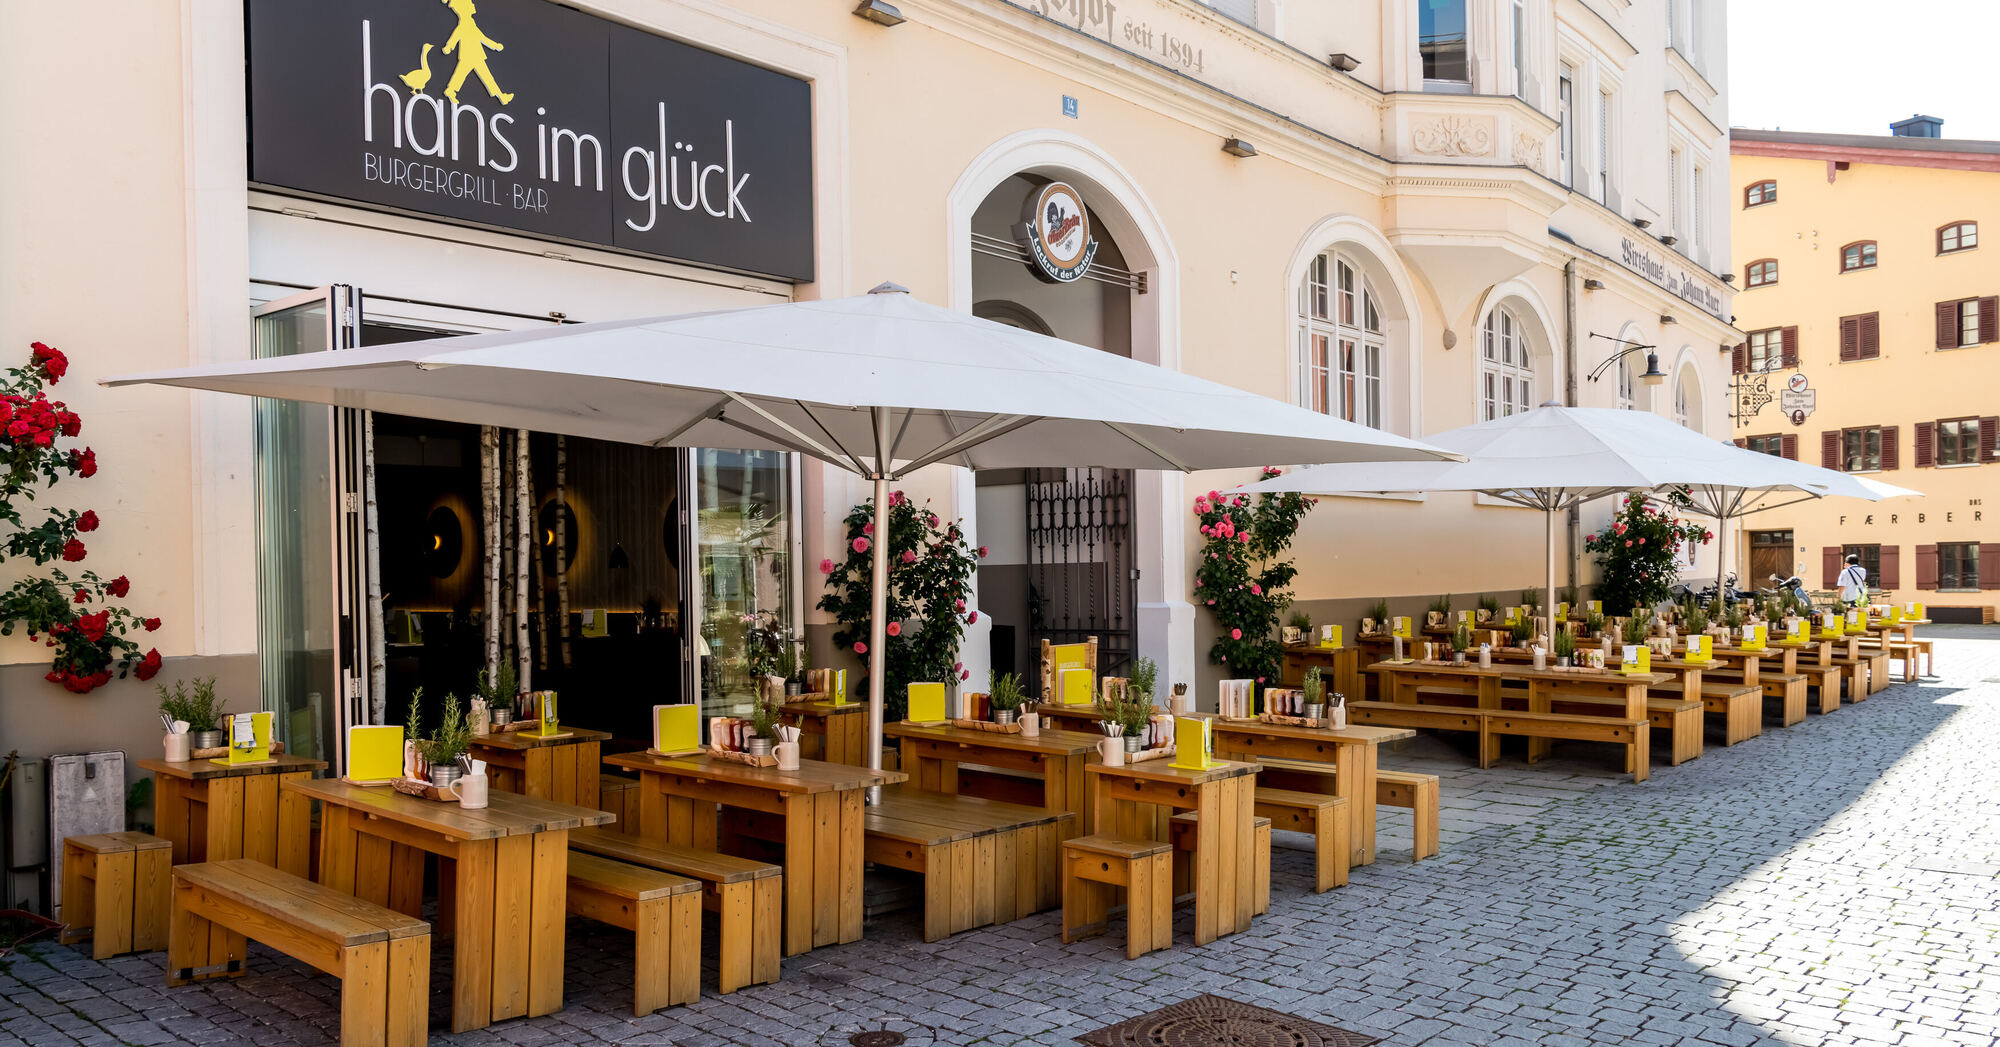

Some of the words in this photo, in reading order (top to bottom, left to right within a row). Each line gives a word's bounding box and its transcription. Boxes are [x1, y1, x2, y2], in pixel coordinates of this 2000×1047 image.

[1123, 21, 1153, 51] seit
[1160, 31, 1204, 73] 1894
[363, 19, 518, 173] hans
[537, 107, 603, 191] im
[621, 101, 752, 231] glück
[365, 152, 502, 206] BURGERGRILL
[513, 183, 549, 215] BAR
[1034, 237, 1059, 276] Lockruf
[1060, 269, 1073, 279] der
[1073, 250, 1091, 276] Natur
